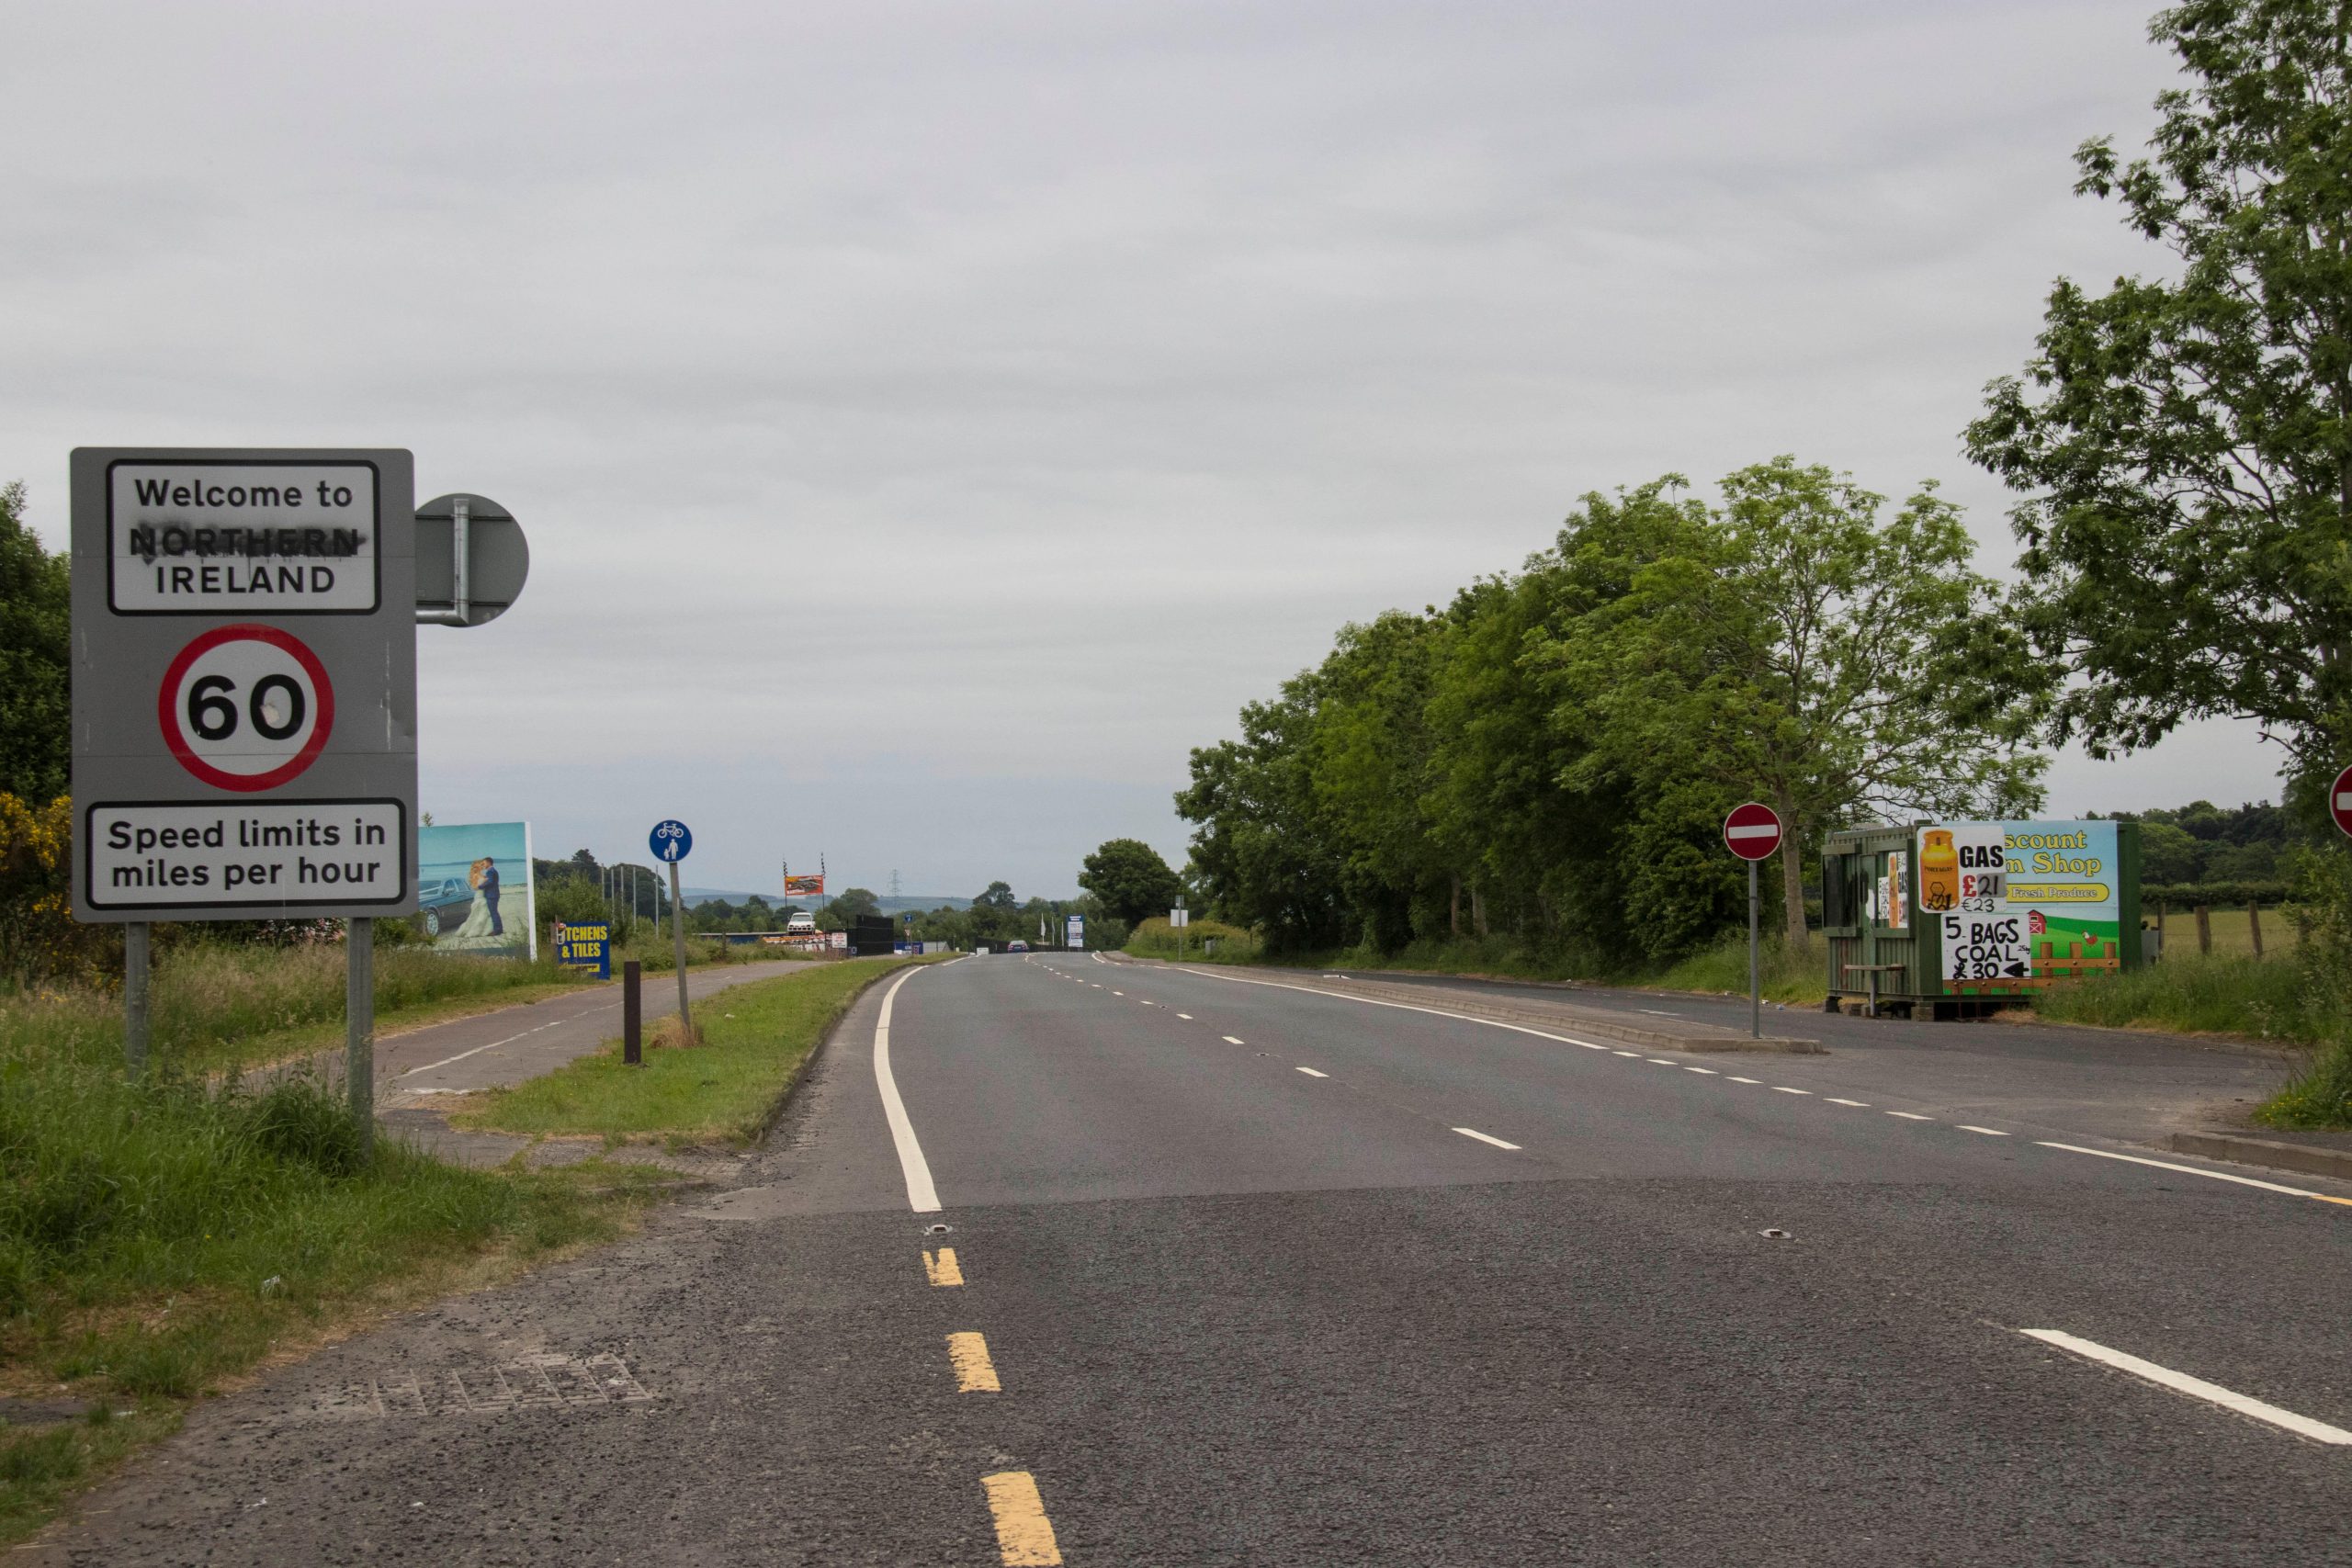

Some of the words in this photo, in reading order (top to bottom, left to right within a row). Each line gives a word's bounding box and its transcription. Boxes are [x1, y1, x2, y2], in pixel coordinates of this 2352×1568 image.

[134, 479, 303, 508] Welcome
[316, 479, 354, 508] to
[129, 527, 359, 557] NORTHERN
[156, 566, 335, 593] IRELAND
[187, 673, 306, 741] 60
[107, 820, 224, 855] Speed
[239, 818, 341, 848] limits
[355, 818, 386, 845] in
[2004, 829, 2087, 850] scount
[1959, 845, 2004, 868] GAS
[2032, 851, 2102, 877] Shop
[112, 859, 210, 887] miles
[224, 863, 283, 891] per
[299, 856, 380, 884] hour
[1961, 897, 1995, 912] €23
[2012, 887, 2045, 897] Fresh
[2048, 887, 2098, 897] Produce
[562, 925, 608, 942] TCHENS
[1971, 919, 2019, 945] BAGS
[561, 945, 571, 958] &
[571, 942, 602, 958] TILES
[1954, 944, 2019, 963] COAL
